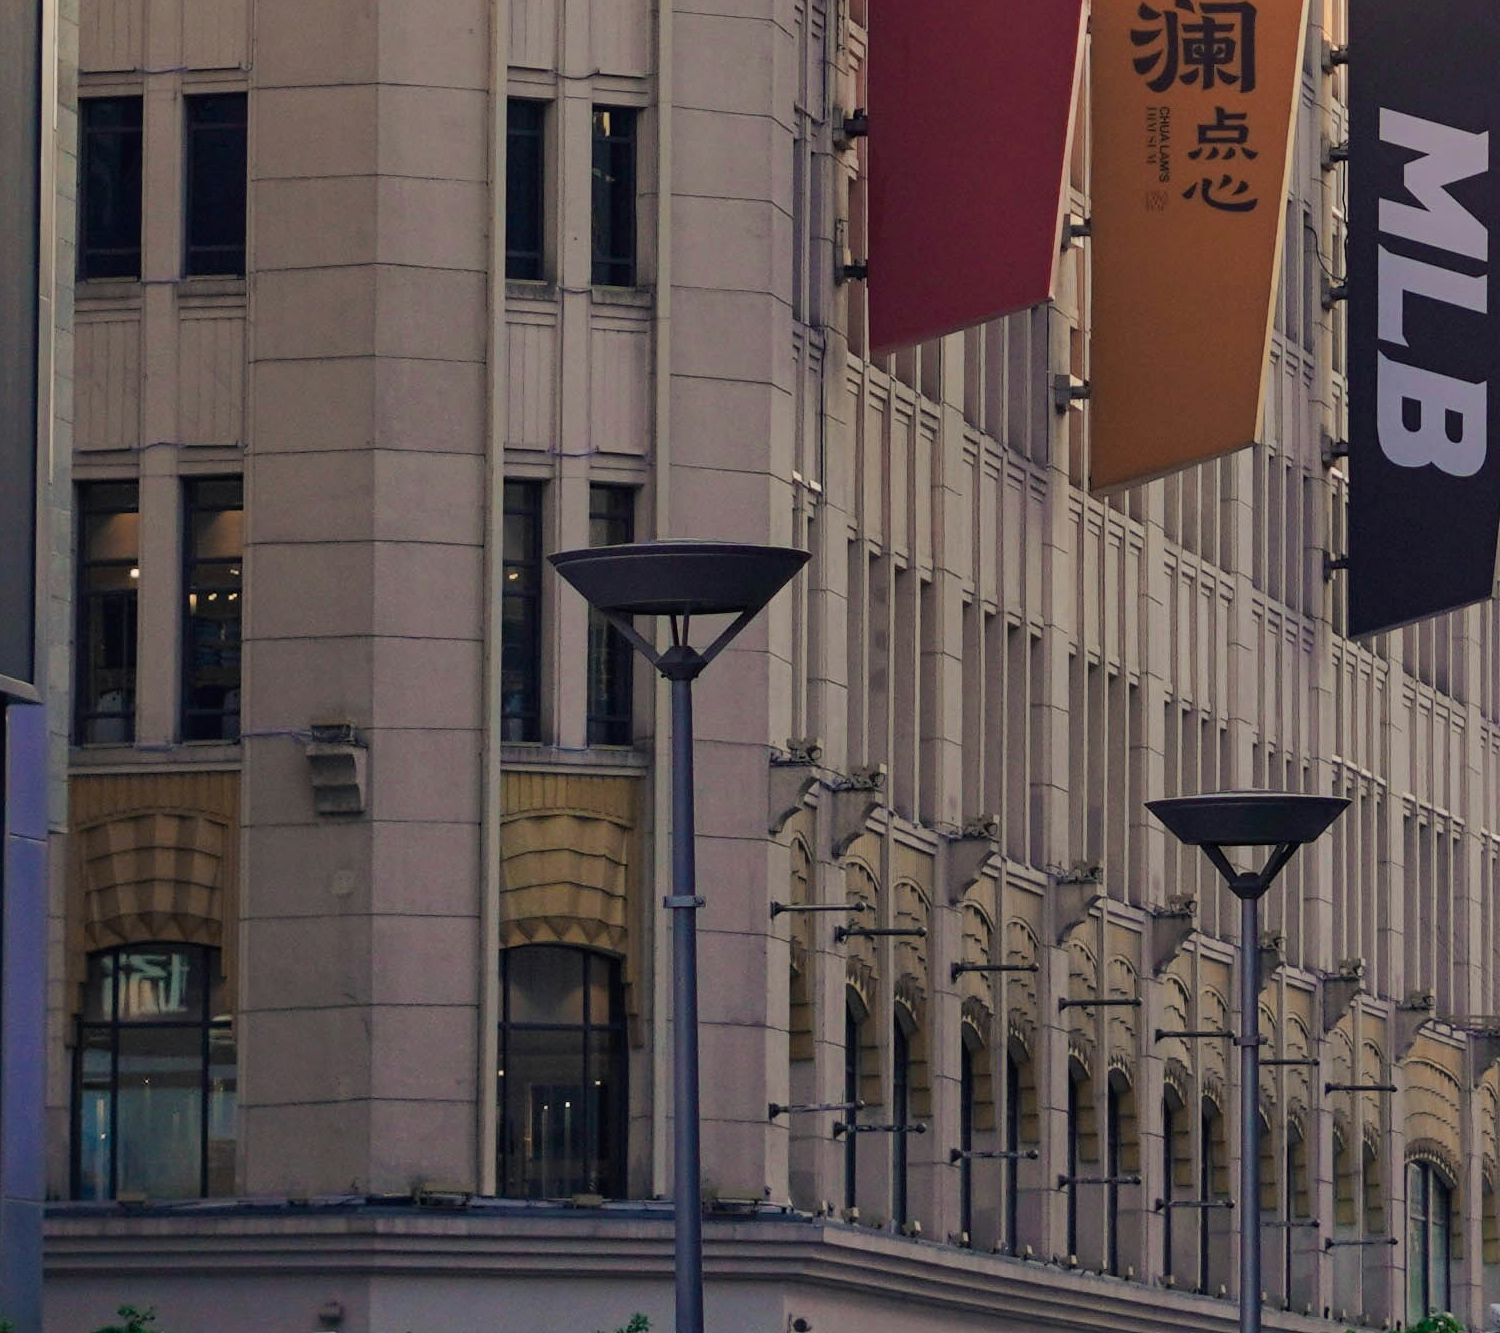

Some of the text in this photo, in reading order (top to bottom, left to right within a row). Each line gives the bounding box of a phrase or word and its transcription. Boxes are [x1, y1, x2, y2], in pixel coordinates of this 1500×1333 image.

[1159, 106, 1170, 142] CHUA
[1181, 105, 1260, 214] 点心
[1376, 106, 1490, 479] MLB
